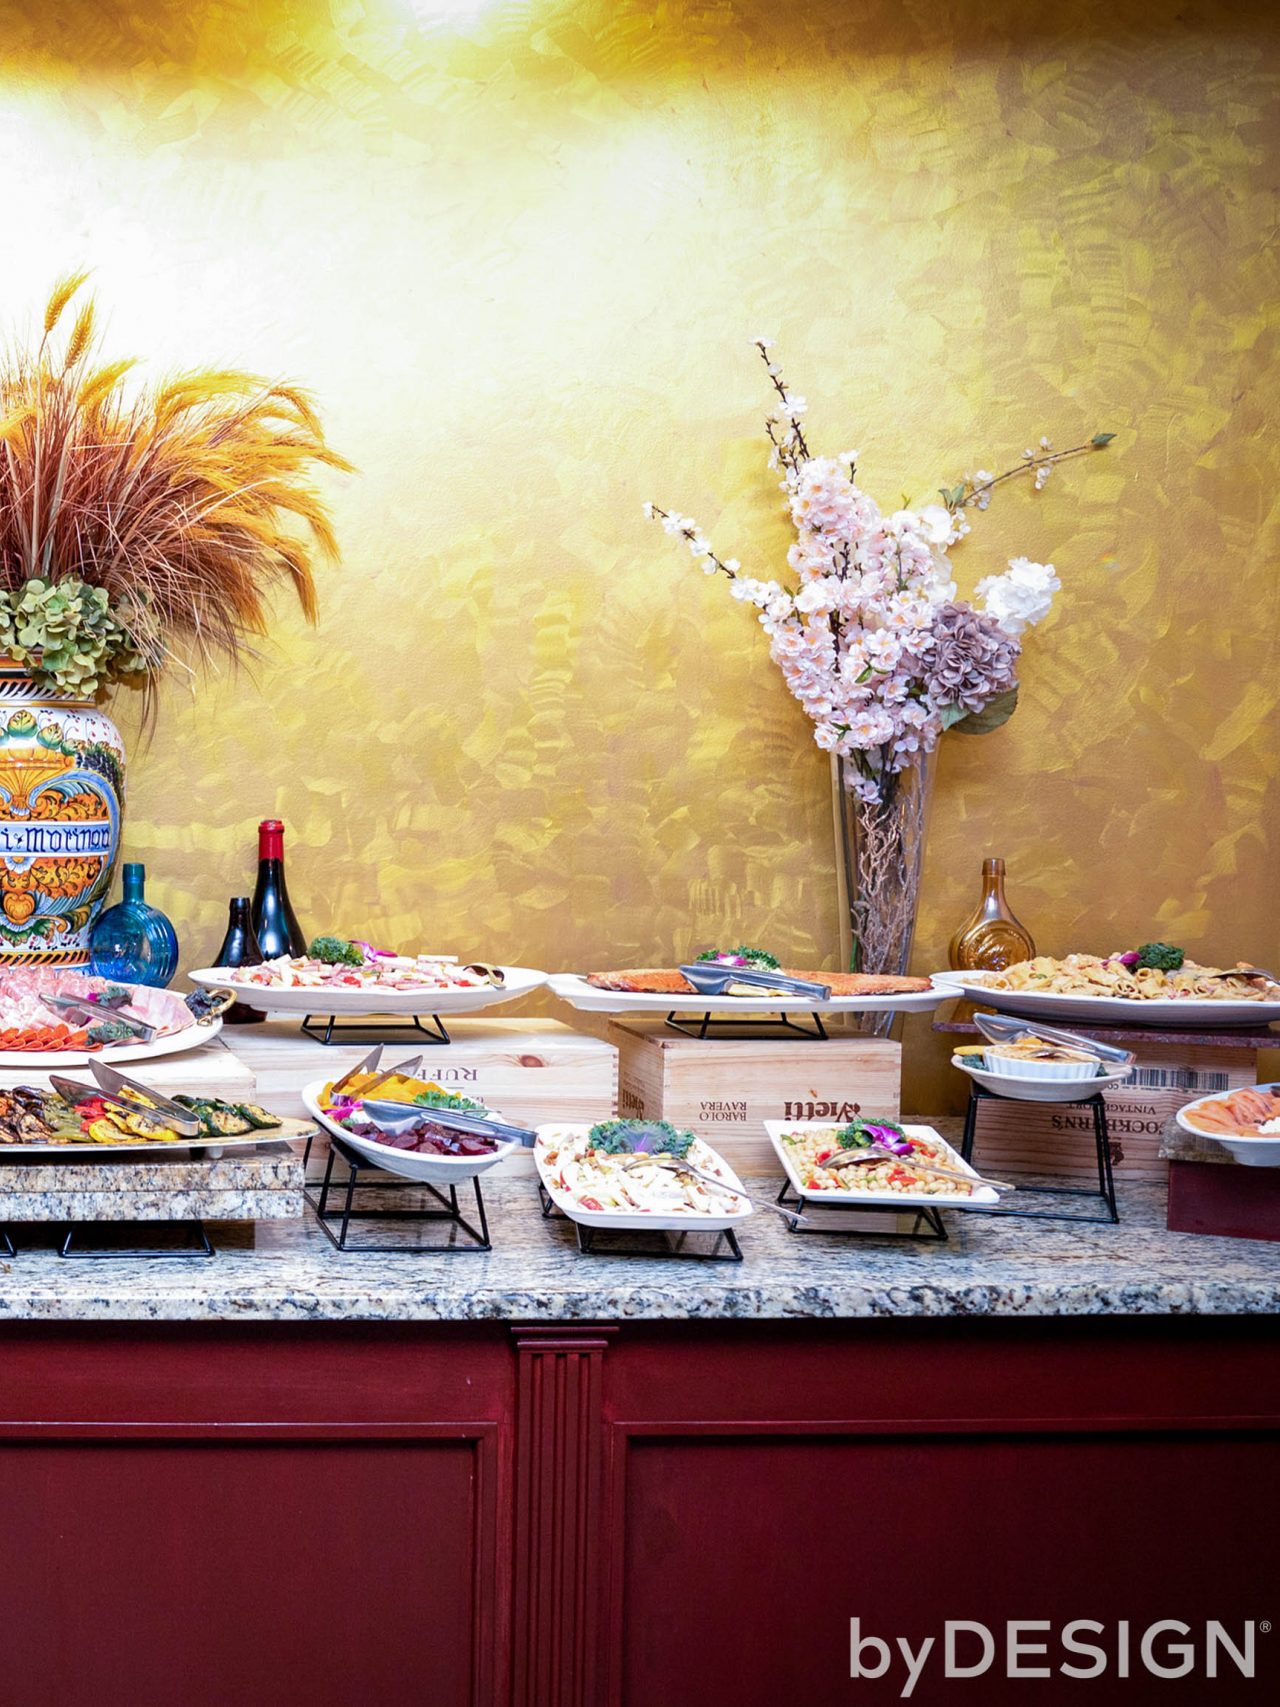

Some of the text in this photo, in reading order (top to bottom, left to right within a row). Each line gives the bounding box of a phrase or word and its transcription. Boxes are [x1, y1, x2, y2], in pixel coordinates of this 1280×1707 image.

[700, 1101, 747, 1111] RAVERA
[784, 1101, 861, 1123] Vietti
[699, 1111, 747, 1121] BAROLO
[1052, 1115, 1164, 1135] OCKBRN'S
